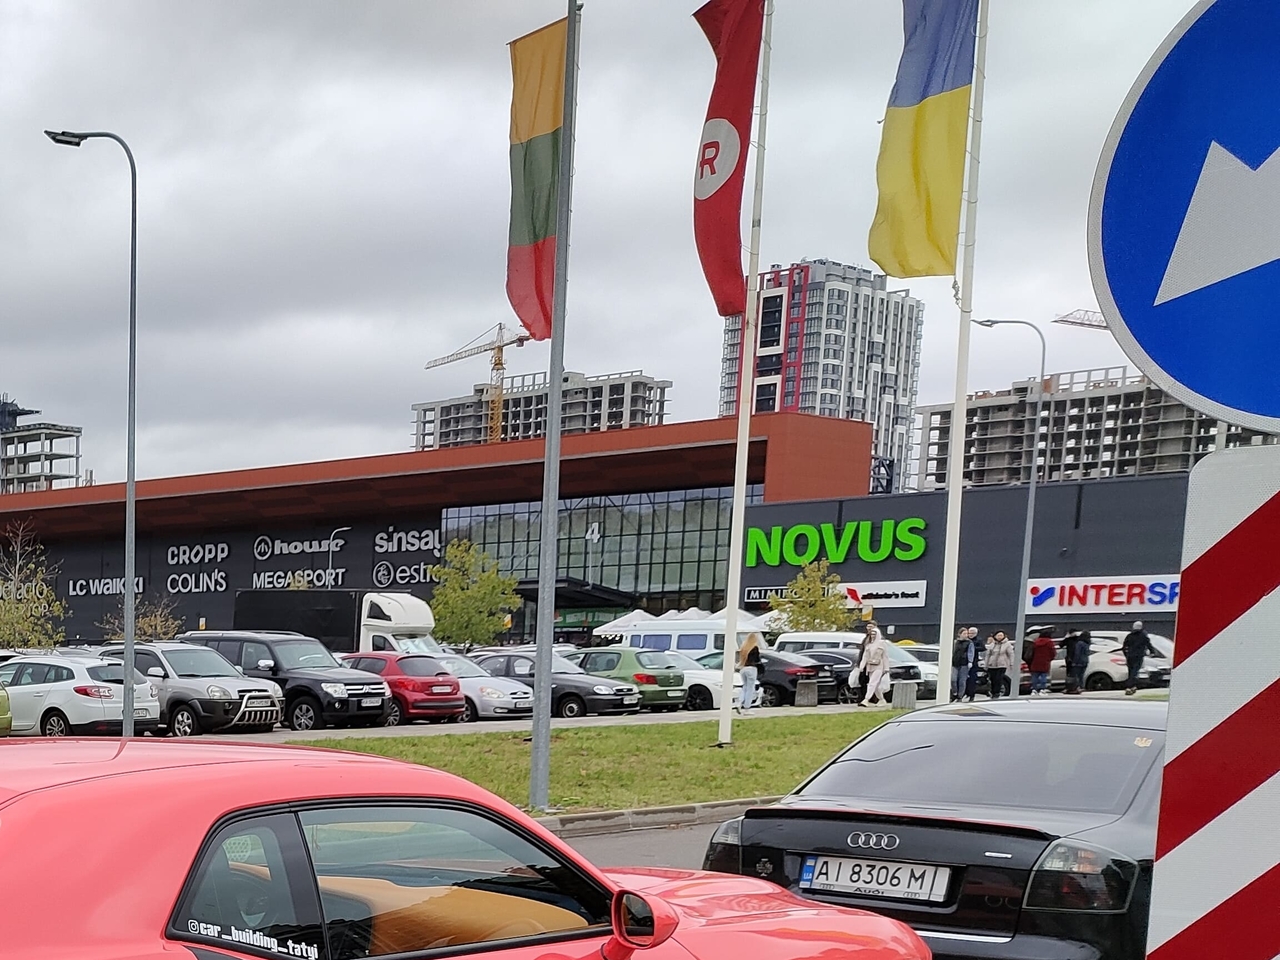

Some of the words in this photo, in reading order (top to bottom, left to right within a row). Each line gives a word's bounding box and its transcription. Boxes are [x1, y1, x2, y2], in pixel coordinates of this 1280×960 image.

[699, 140, 720, 180] R
[585, 522, 601, 543] 4
[745, 517, 927, 567] NOVUS
[167, 543, 229, 565] CROPP
[274, 538, 346, 556] house
[69, 579, 87, 596] LC
[167, 568, 227, 593] COLIN'S
[252, 568, 346, 590] MEGASPORT
[815, 860, 842, 882] AI
[849, 863, 903, 887] 8306
